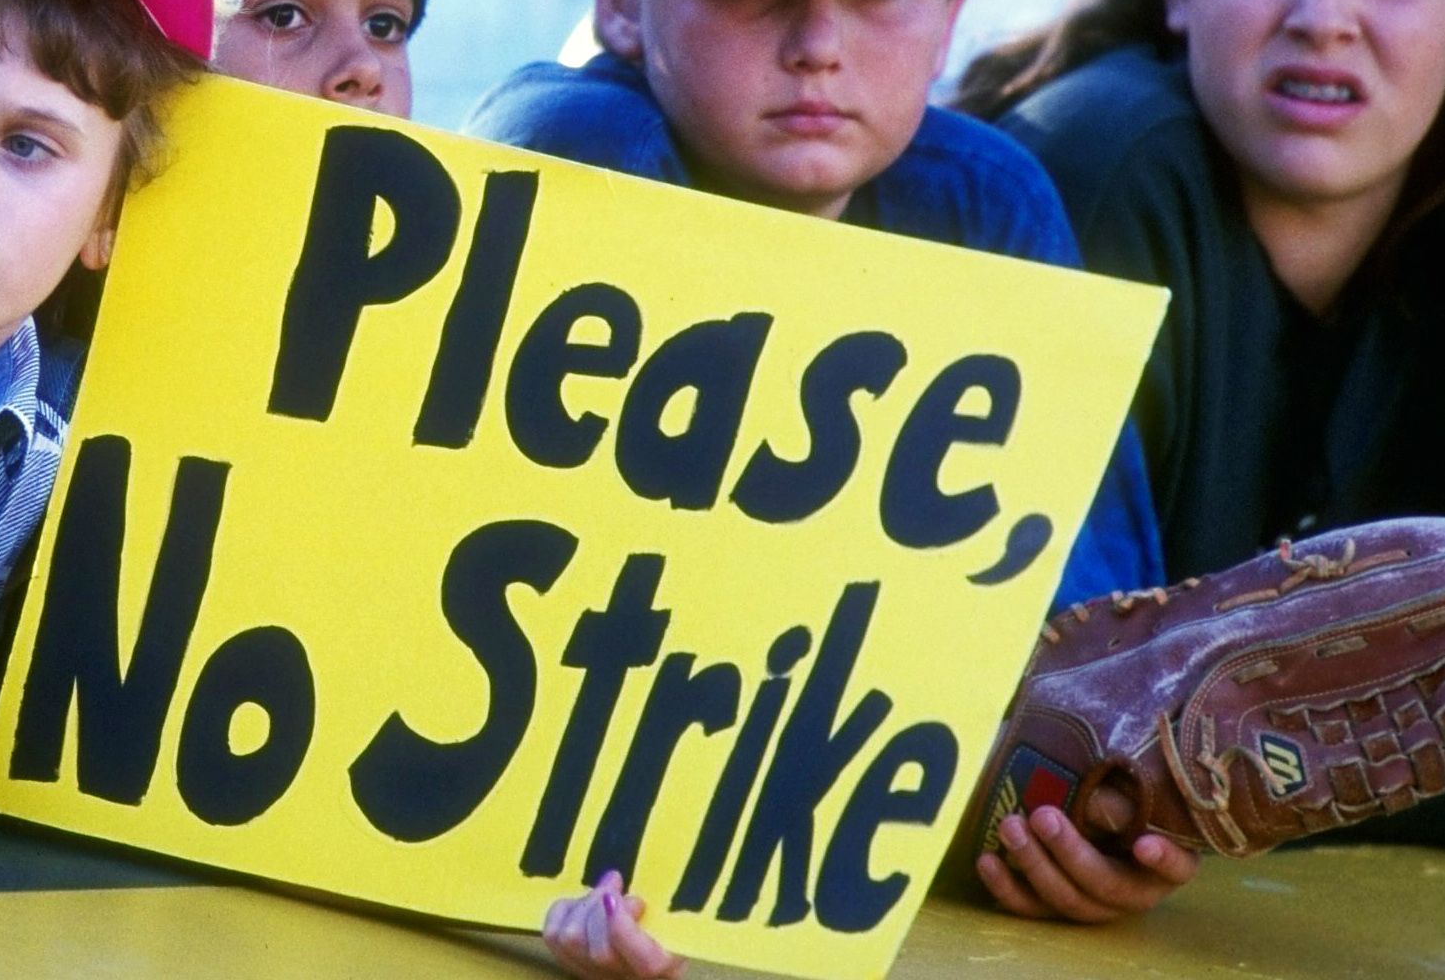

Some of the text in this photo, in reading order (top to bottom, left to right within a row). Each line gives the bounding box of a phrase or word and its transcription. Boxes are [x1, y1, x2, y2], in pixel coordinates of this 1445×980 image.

[267, 125, 1054, 586] Please,
[10, 434, 960, 935] No Strike
